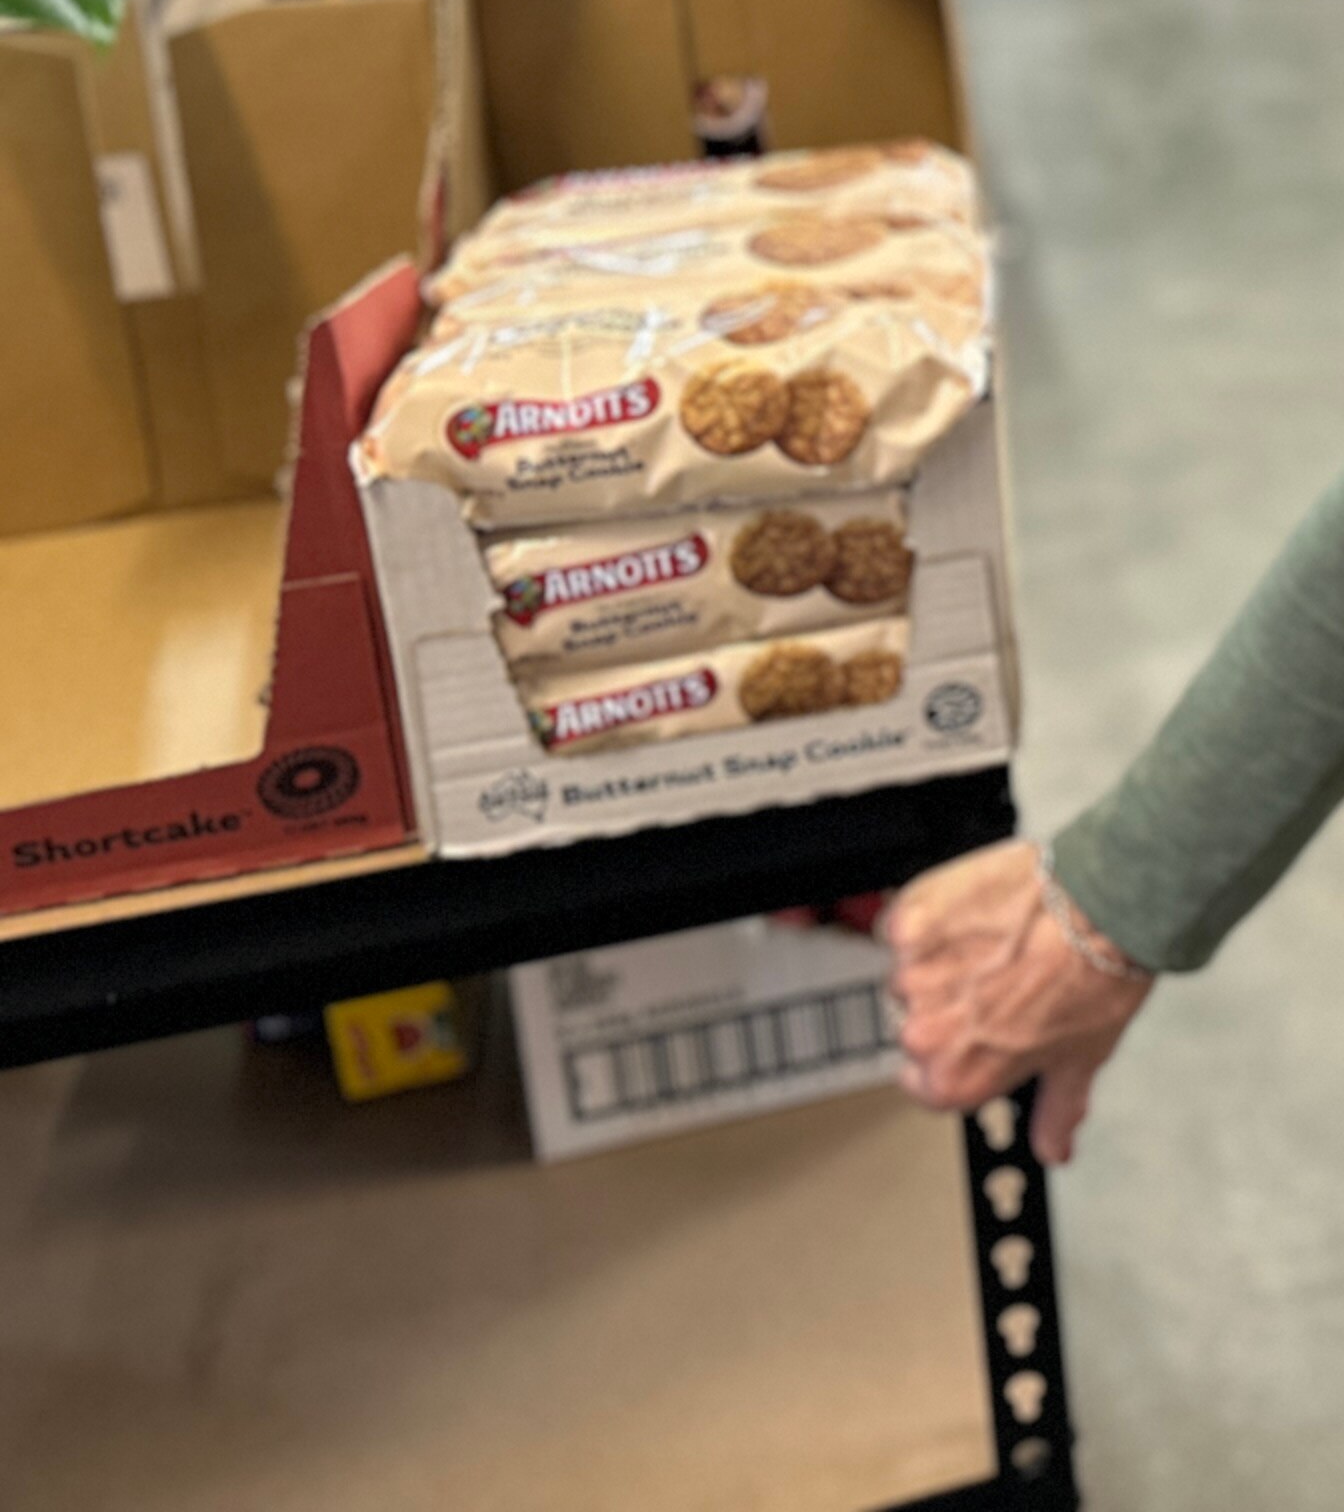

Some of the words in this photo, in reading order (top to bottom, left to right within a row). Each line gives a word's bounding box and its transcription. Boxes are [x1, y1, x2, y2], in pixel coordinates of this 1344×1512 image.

[562, 764, 714, 805] Butternut
[724, 750, 797, 776] Snap
[804, 727, 906, 761] Cookie
[11, 811, 241, 868] Shortcake
